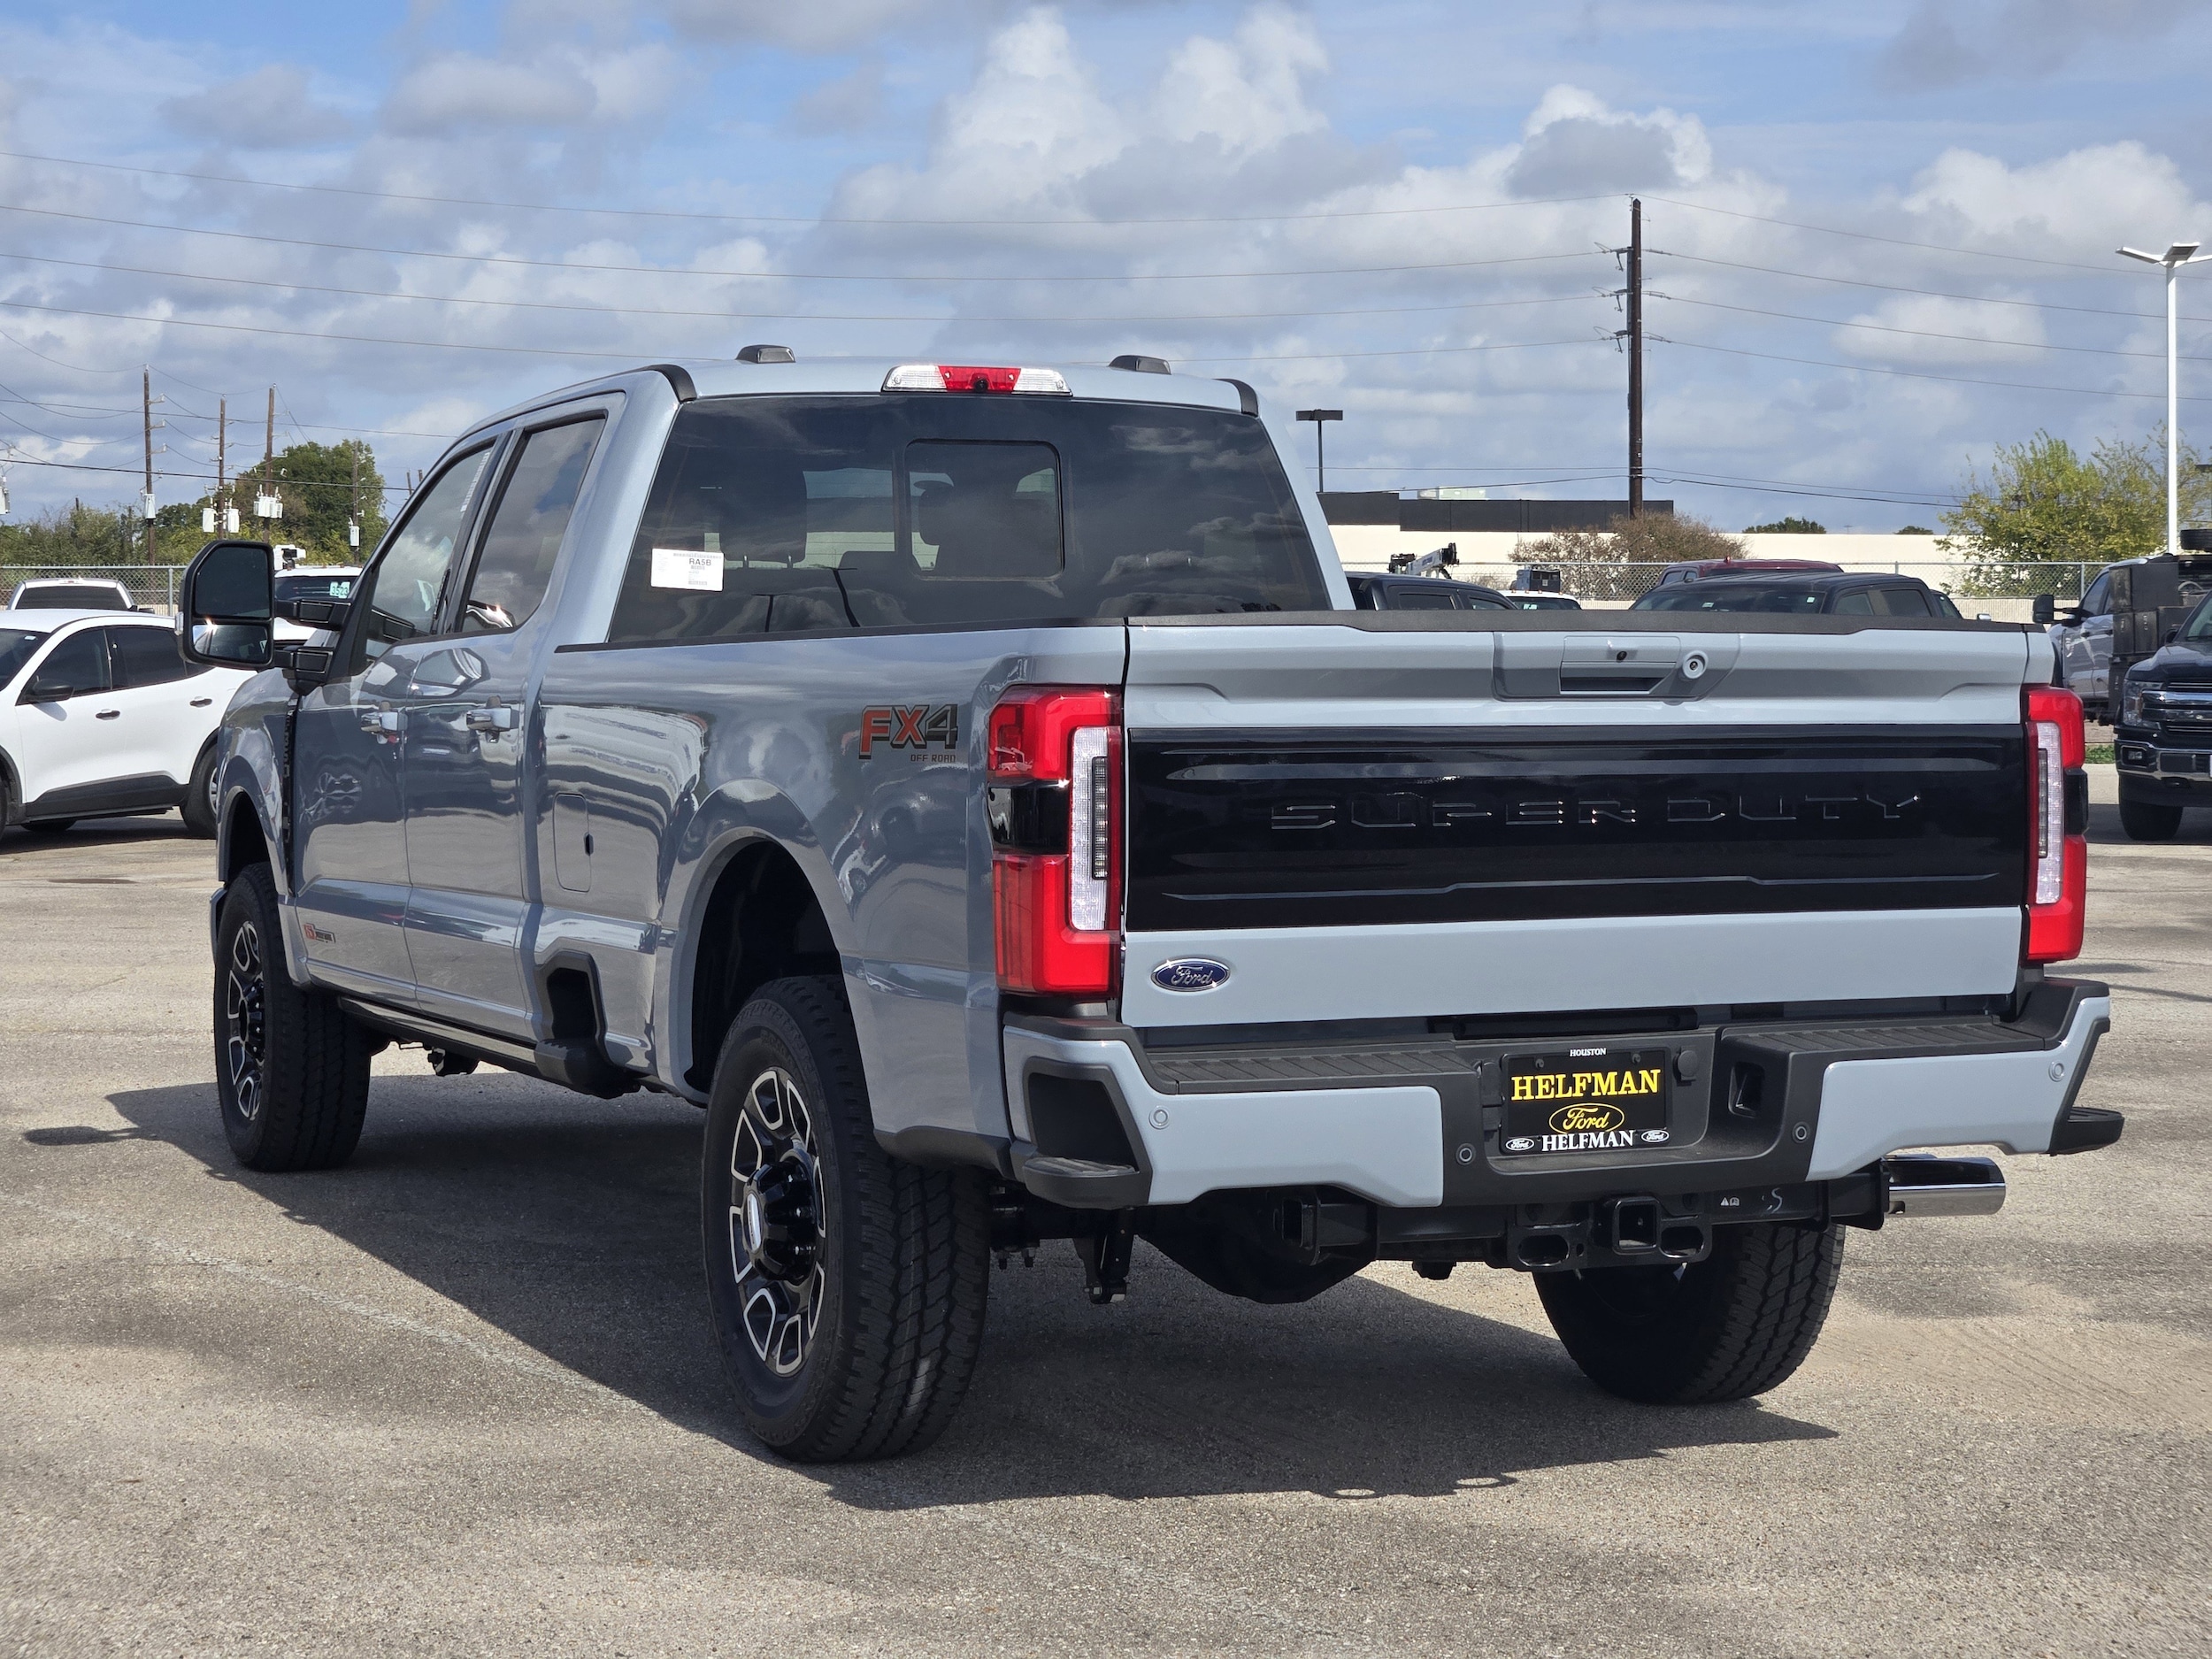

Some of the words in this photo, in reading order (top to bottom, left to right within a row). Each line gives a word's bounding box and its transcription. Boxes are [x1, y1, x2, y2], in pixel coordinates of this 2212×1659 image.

[858, 704, 958, 760] FX4
[931, 754, 956, 763] ROAD
[1271, 799, 1637, 830] SUPER
[1667, 794, 1919, 822] DUTY
[1171, 965, 1213, 986] Ford
[1570, 1048, 1607, 1057] HOUSTON
[1511, 1069, 1662, 1101] HELFMAN
[1563, 1107, 1610, 1131] Ford
[1541, 1129, 1636, 1152] HELFMAN
